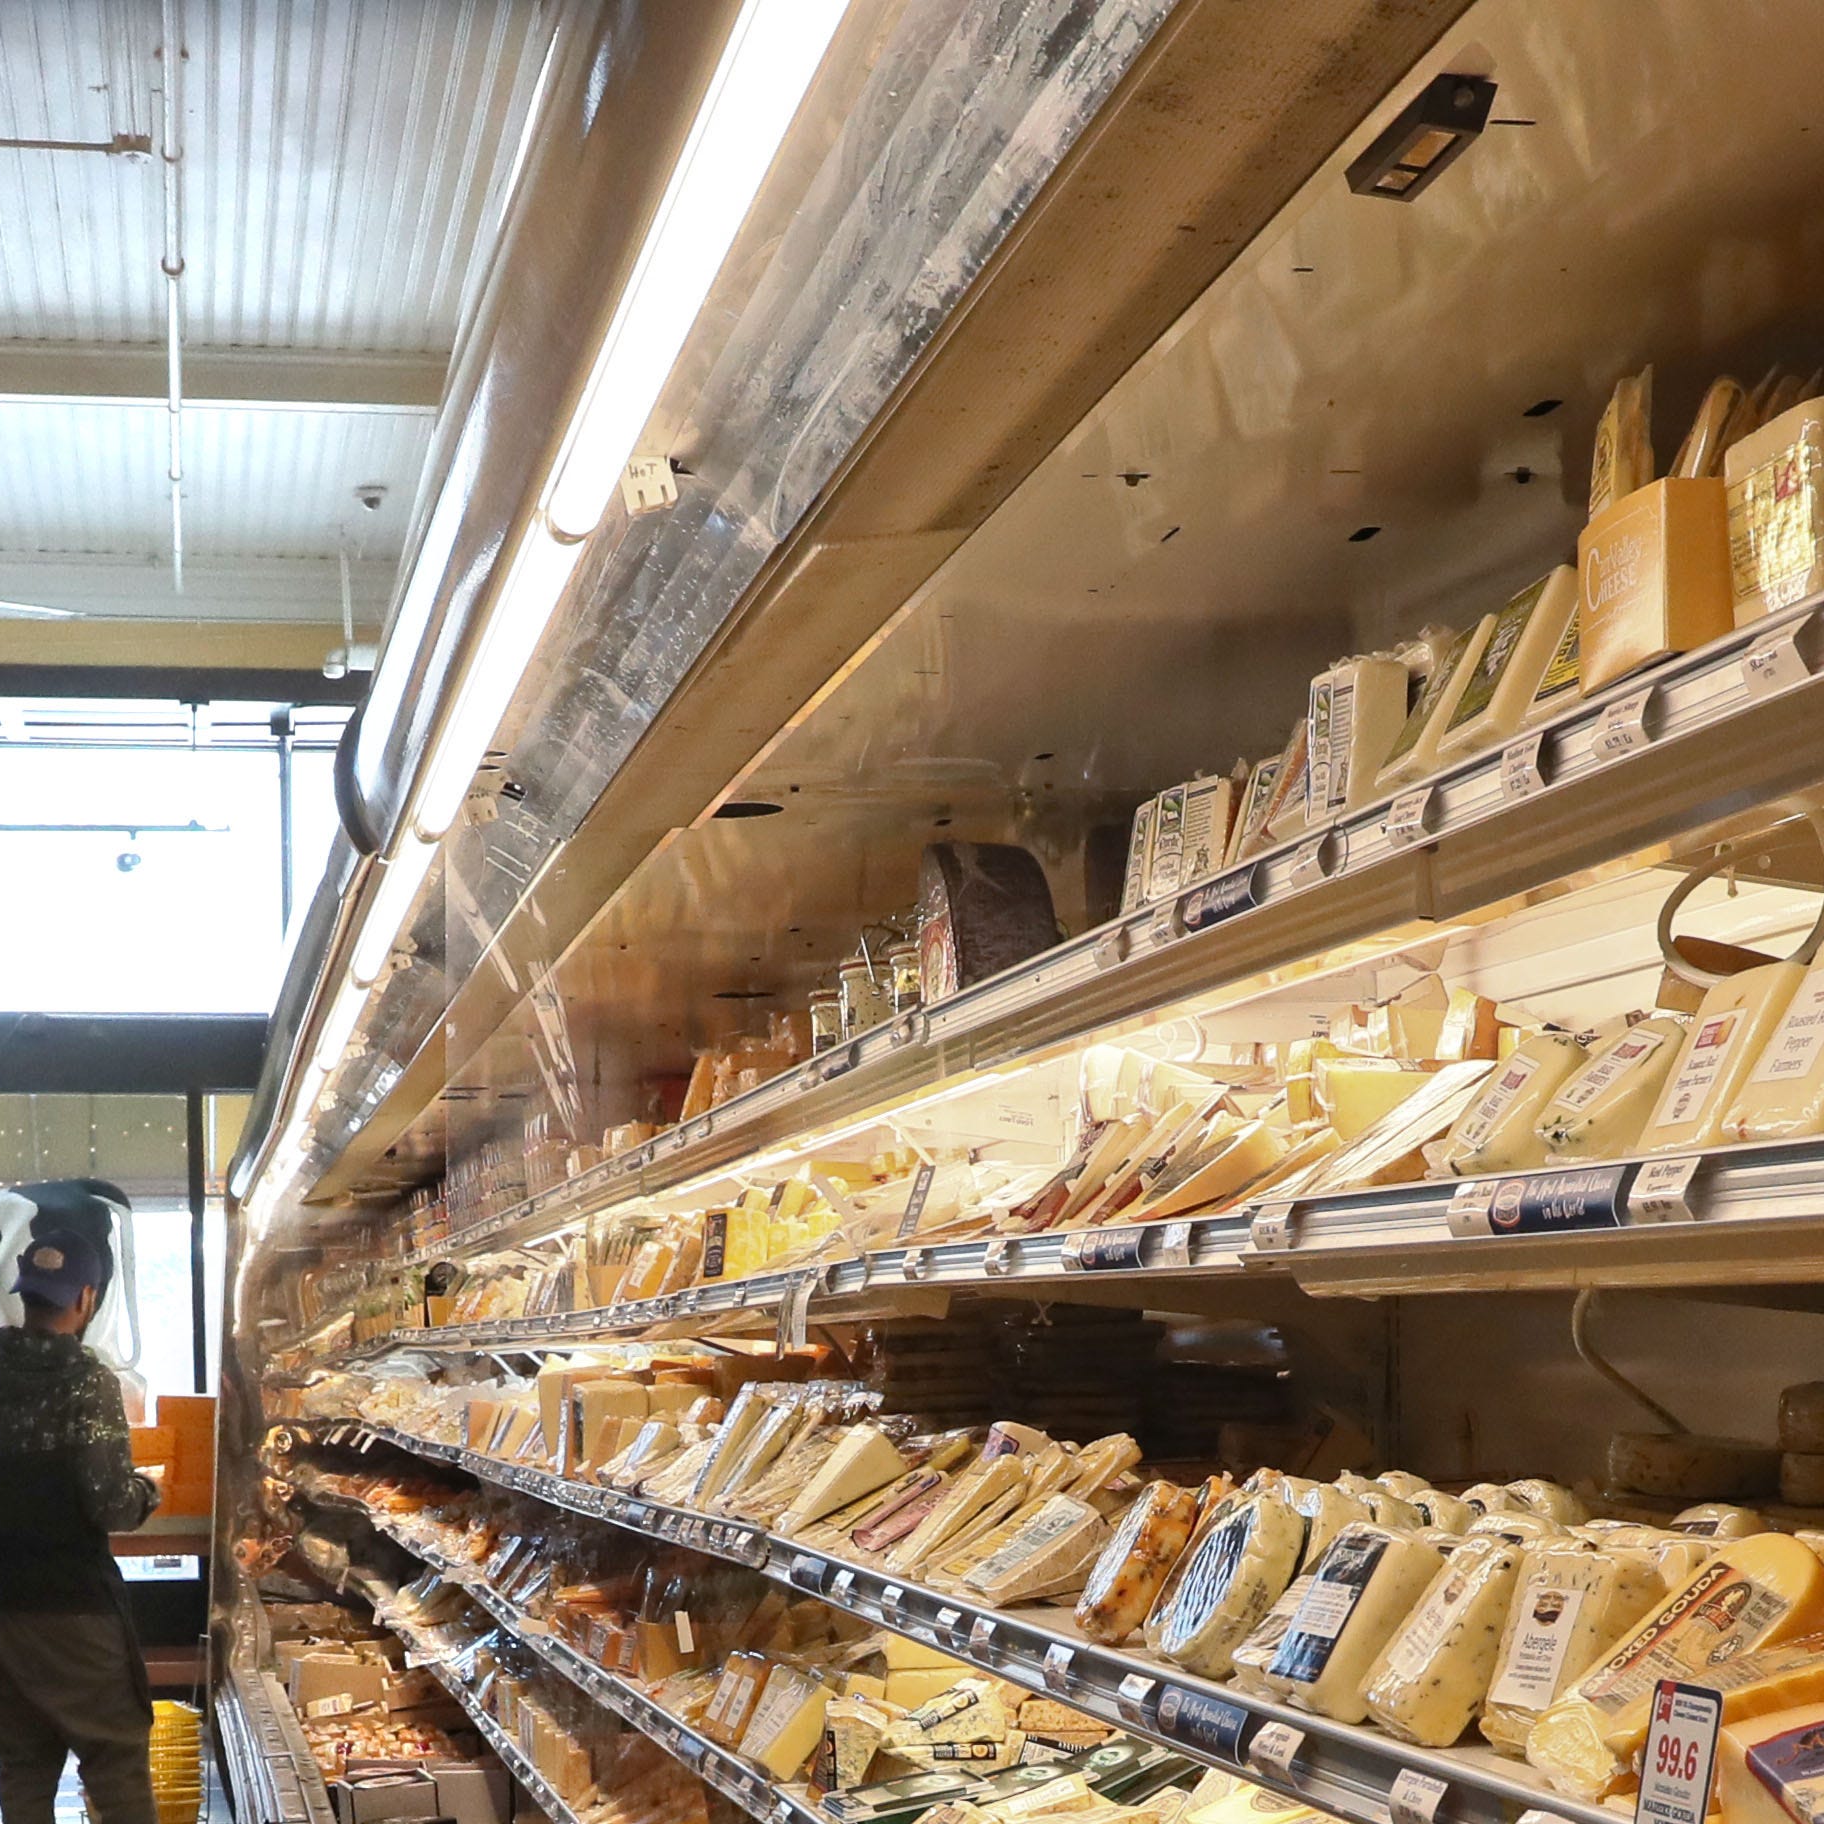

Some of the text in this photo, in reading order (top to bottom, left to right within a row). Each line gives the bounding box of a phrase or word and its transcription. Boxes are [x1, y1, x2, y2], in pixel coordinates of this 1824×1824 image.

[1581, 1563, 1728, 1697] SMOKED GOUDA
[1656, 1734, 1699, 1782] 99.6
